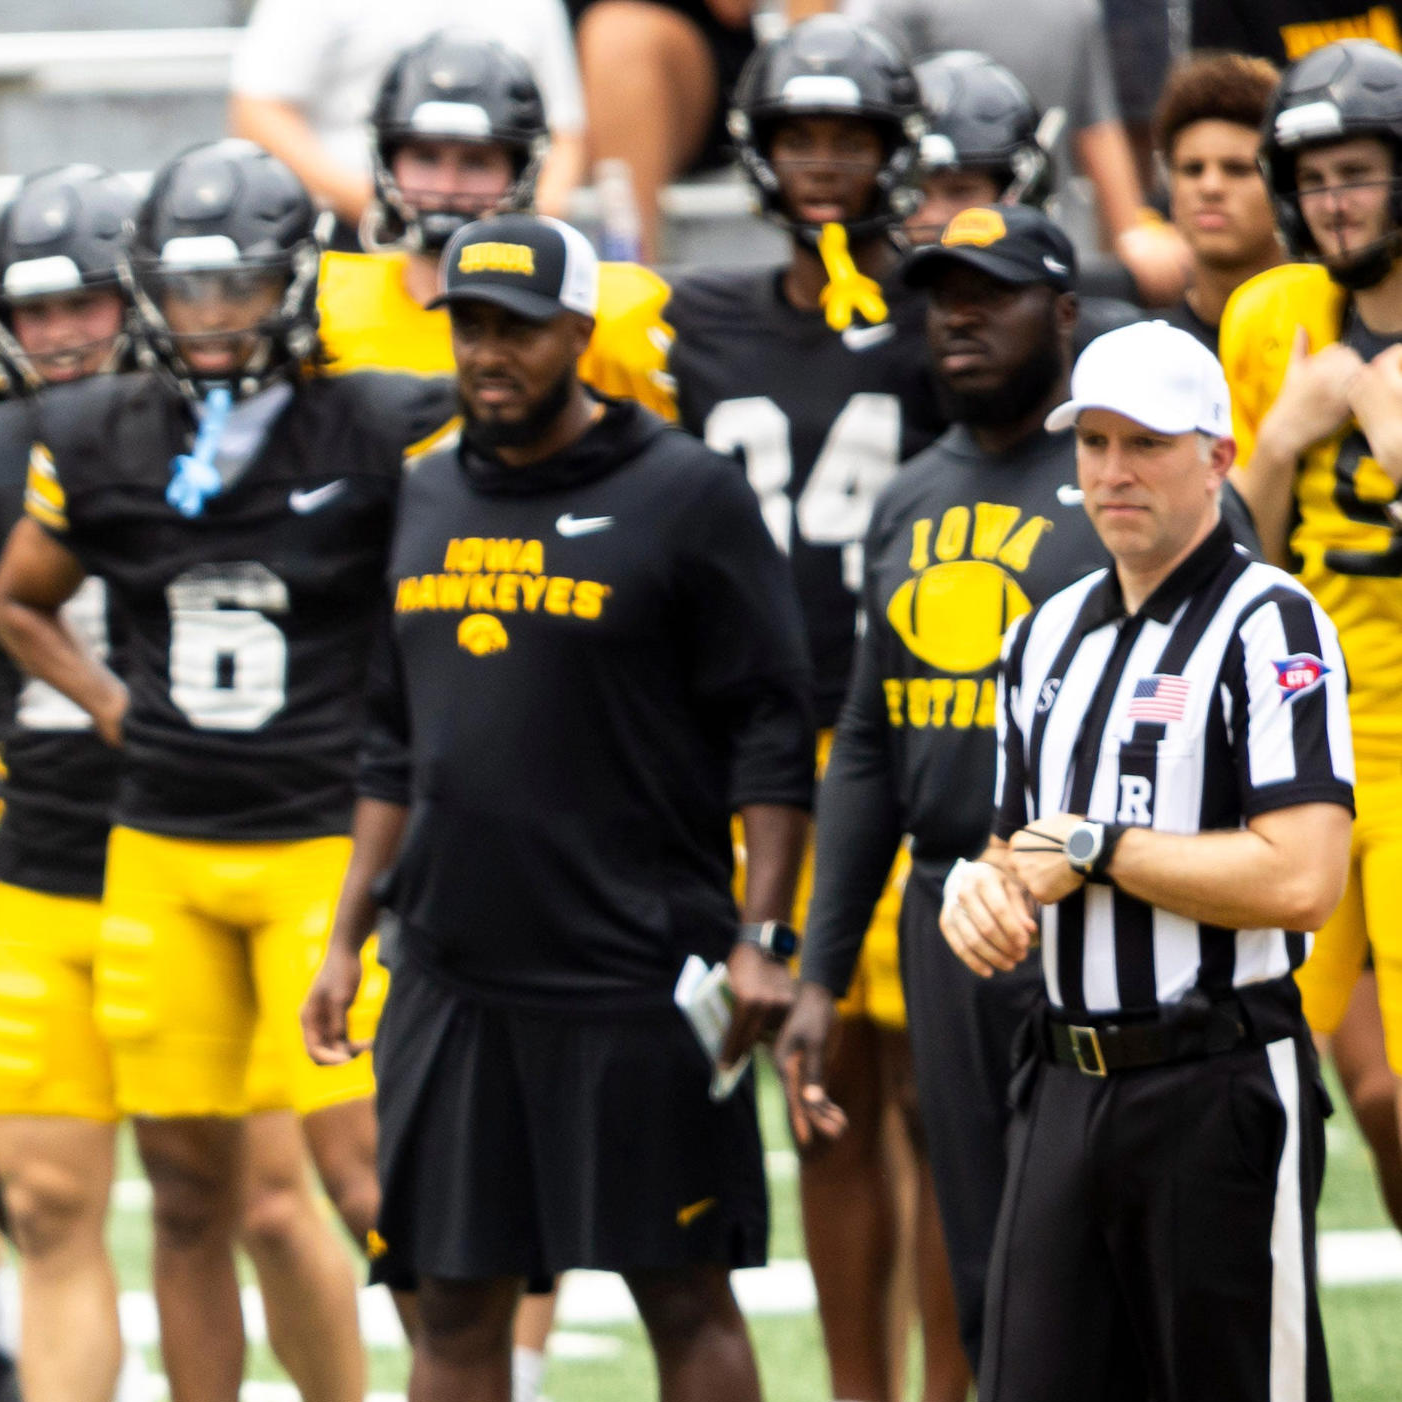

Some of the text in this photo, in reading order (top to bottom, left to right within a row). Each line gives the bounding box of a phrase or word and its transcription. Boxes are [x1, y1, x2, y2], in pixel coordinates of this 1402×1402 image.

[444, 537, 543, 574] IOWA
[909, 502, 1047, 572] IOWA
[395, 573, 605, 621] HAWKEYES
[165, 560, 290, 733] 6
[1036, 678, 1062, 713] S
[1117, 774, 1152, 824] R
